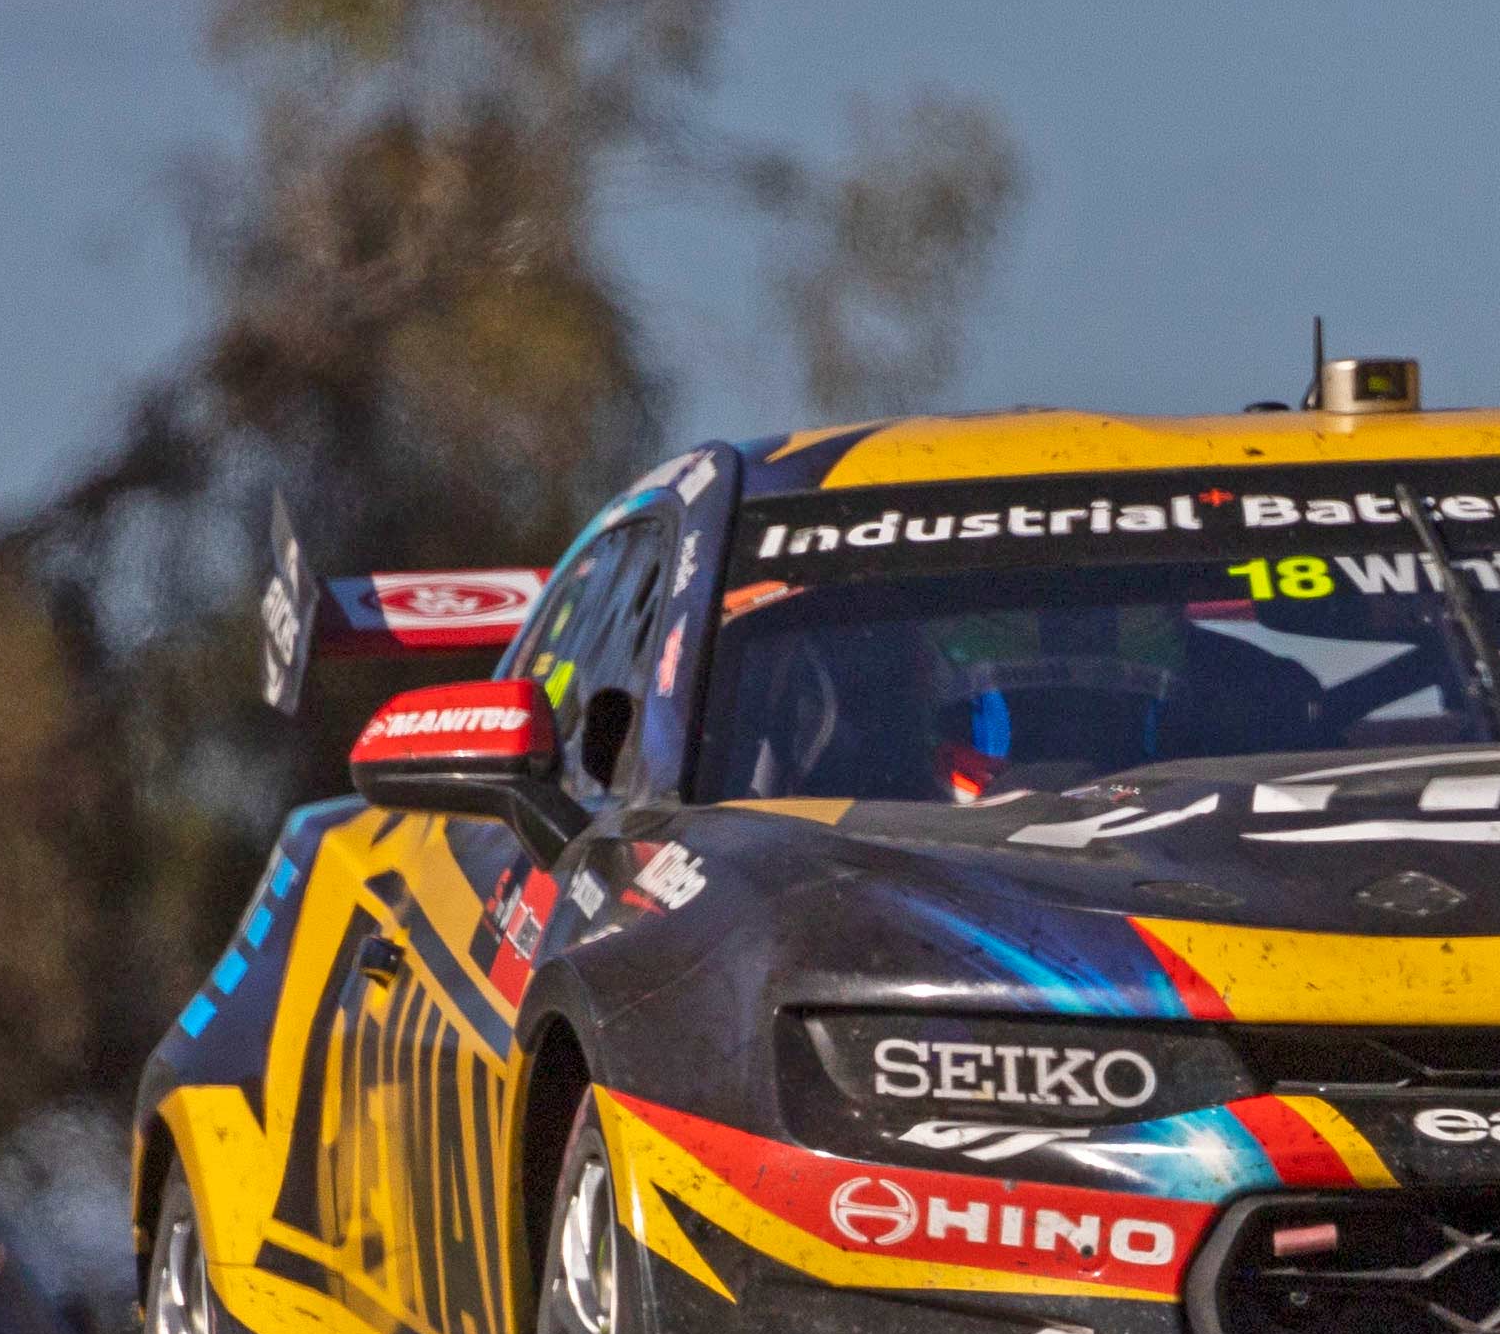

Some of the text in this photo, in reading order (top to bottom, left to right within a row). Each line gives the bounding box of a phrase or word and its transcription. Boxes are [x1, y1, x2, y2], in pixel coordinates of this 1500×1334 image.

[757, 493, 1203, 559] Industrial
[1227, 554, 1336, 600] 18
[384, 705, 532, 739] MANITOU
[873, 1037, 1158, 1108] SEIKO
[925, 1195, 1176, 1267] HINO
